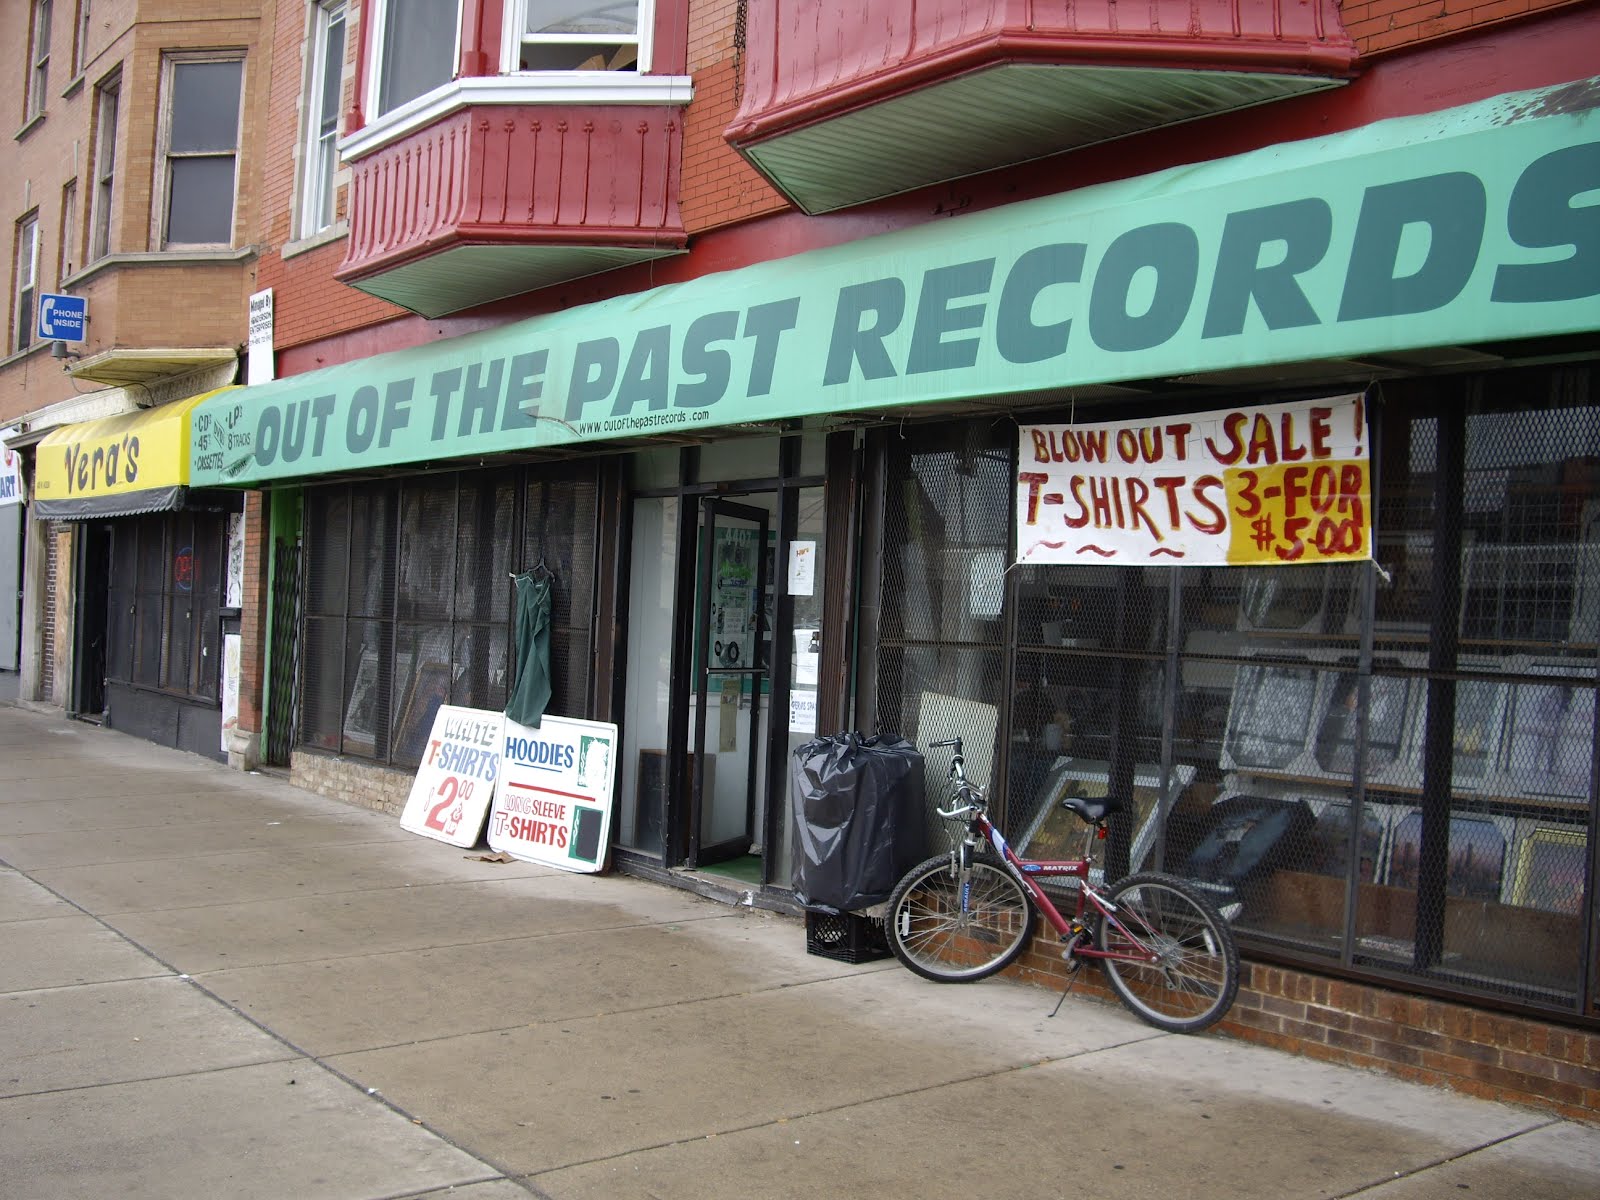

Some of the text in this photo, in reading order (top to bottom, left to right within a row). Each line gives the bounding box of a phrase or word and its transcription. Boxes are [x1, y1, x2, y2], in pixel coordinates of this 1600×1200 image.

[53, 309, 83, 319] PHONE
[255, 141, 1600, 467] OUT OF THE PAST RECORDS
[53, 318, 81, 328] INSIDE
[1031, 428, 1107, 464] BLOW
[1117, 423, 1192, 463] OUT
[1205, 407, 1333, 465] SALE
[65, 433, 140, 494] Vera's
[1019, 472, 1228, 542] T-SHIRTS
[444, 717, 498, 747] WHITE
[428, 740, 500, 782] T-SHIRTS
[505, 737, 574, 768] HOODIES
[531, 800, 566, 820] SLEEVE
[495, 811, 568, 848] T-SHIRTS
